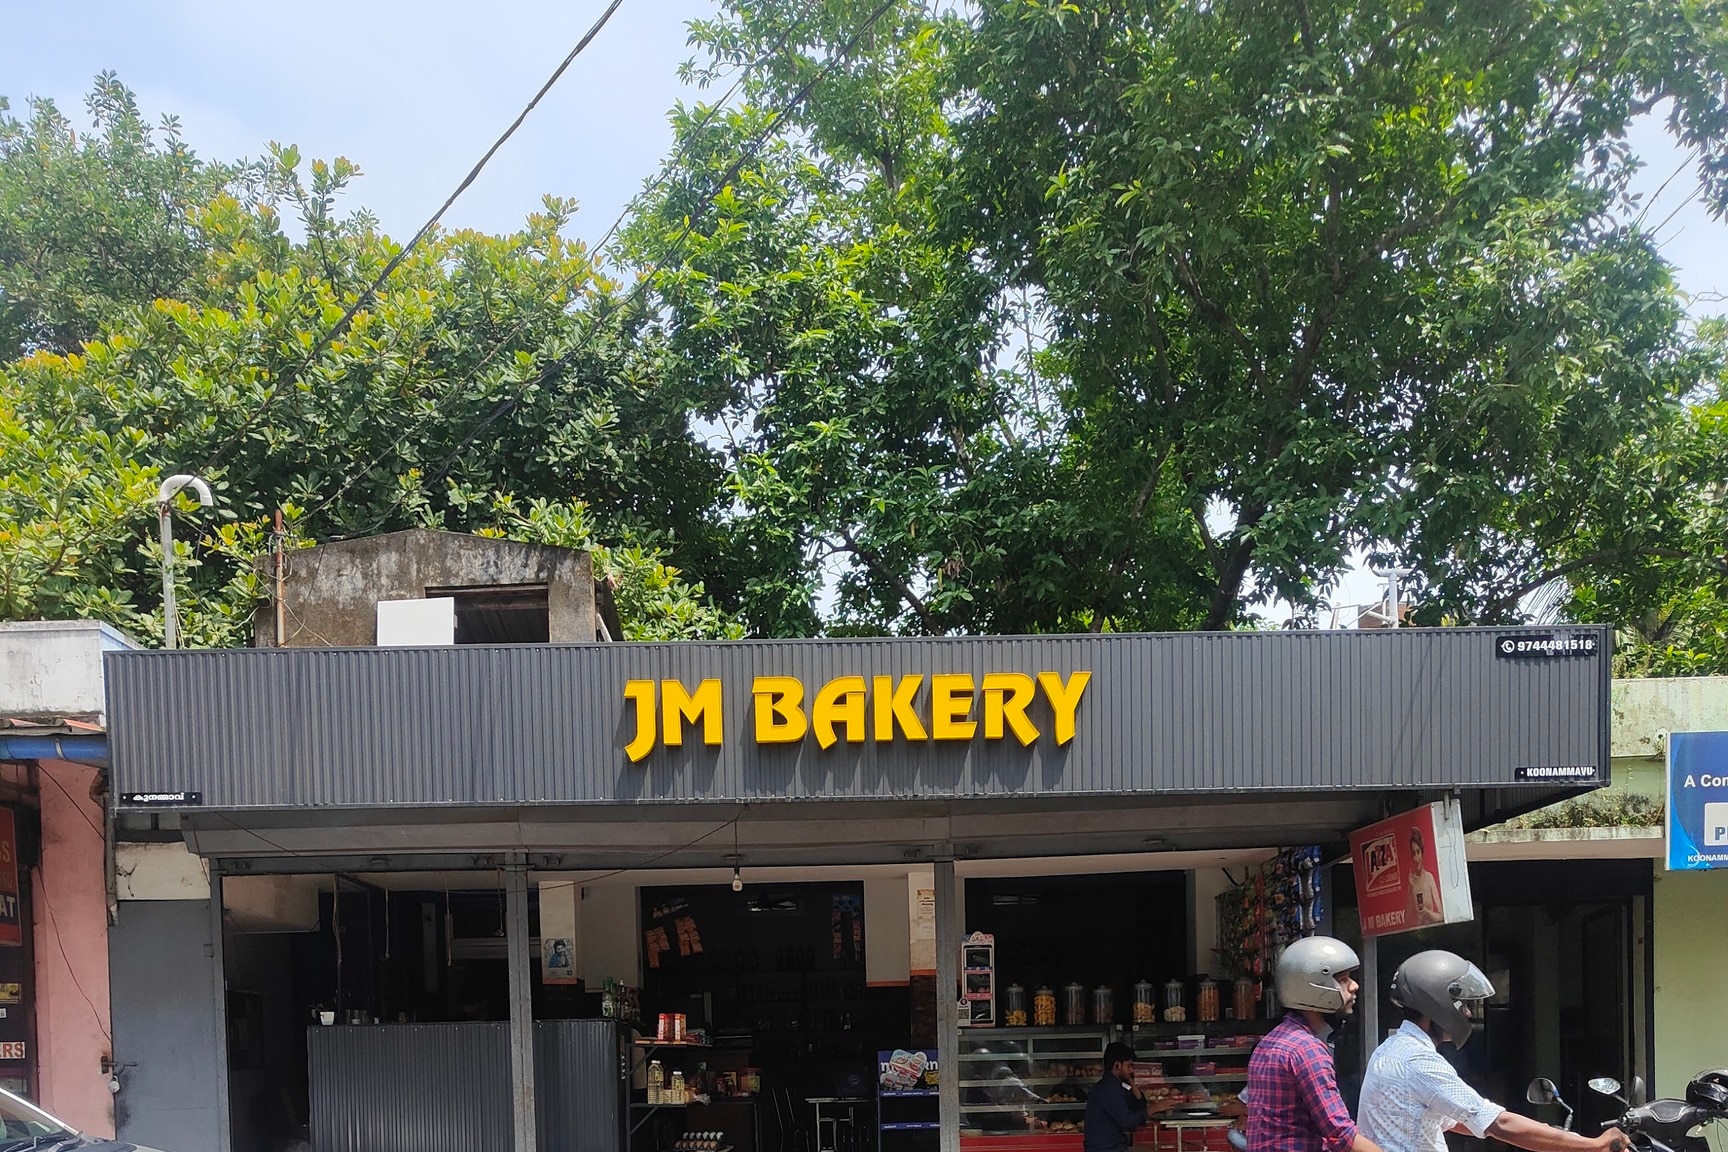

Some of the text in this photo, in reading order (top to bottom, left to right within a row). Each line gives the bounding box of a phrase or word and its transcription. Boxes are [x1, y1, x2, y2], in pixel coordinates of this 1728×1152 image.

[1517, 639, 1593, 652] 9744481518
[623, 671, 1092, 763] JM BAKERY
[1526, 766, 1593, 777] KOONAMMAVU
[1683, 774, 1696, 788] A
[1714, 826, 1728, 841] P
[1375, 909, 1406, 929] BAKERY
[0, 1043, 23, 1058] RS
